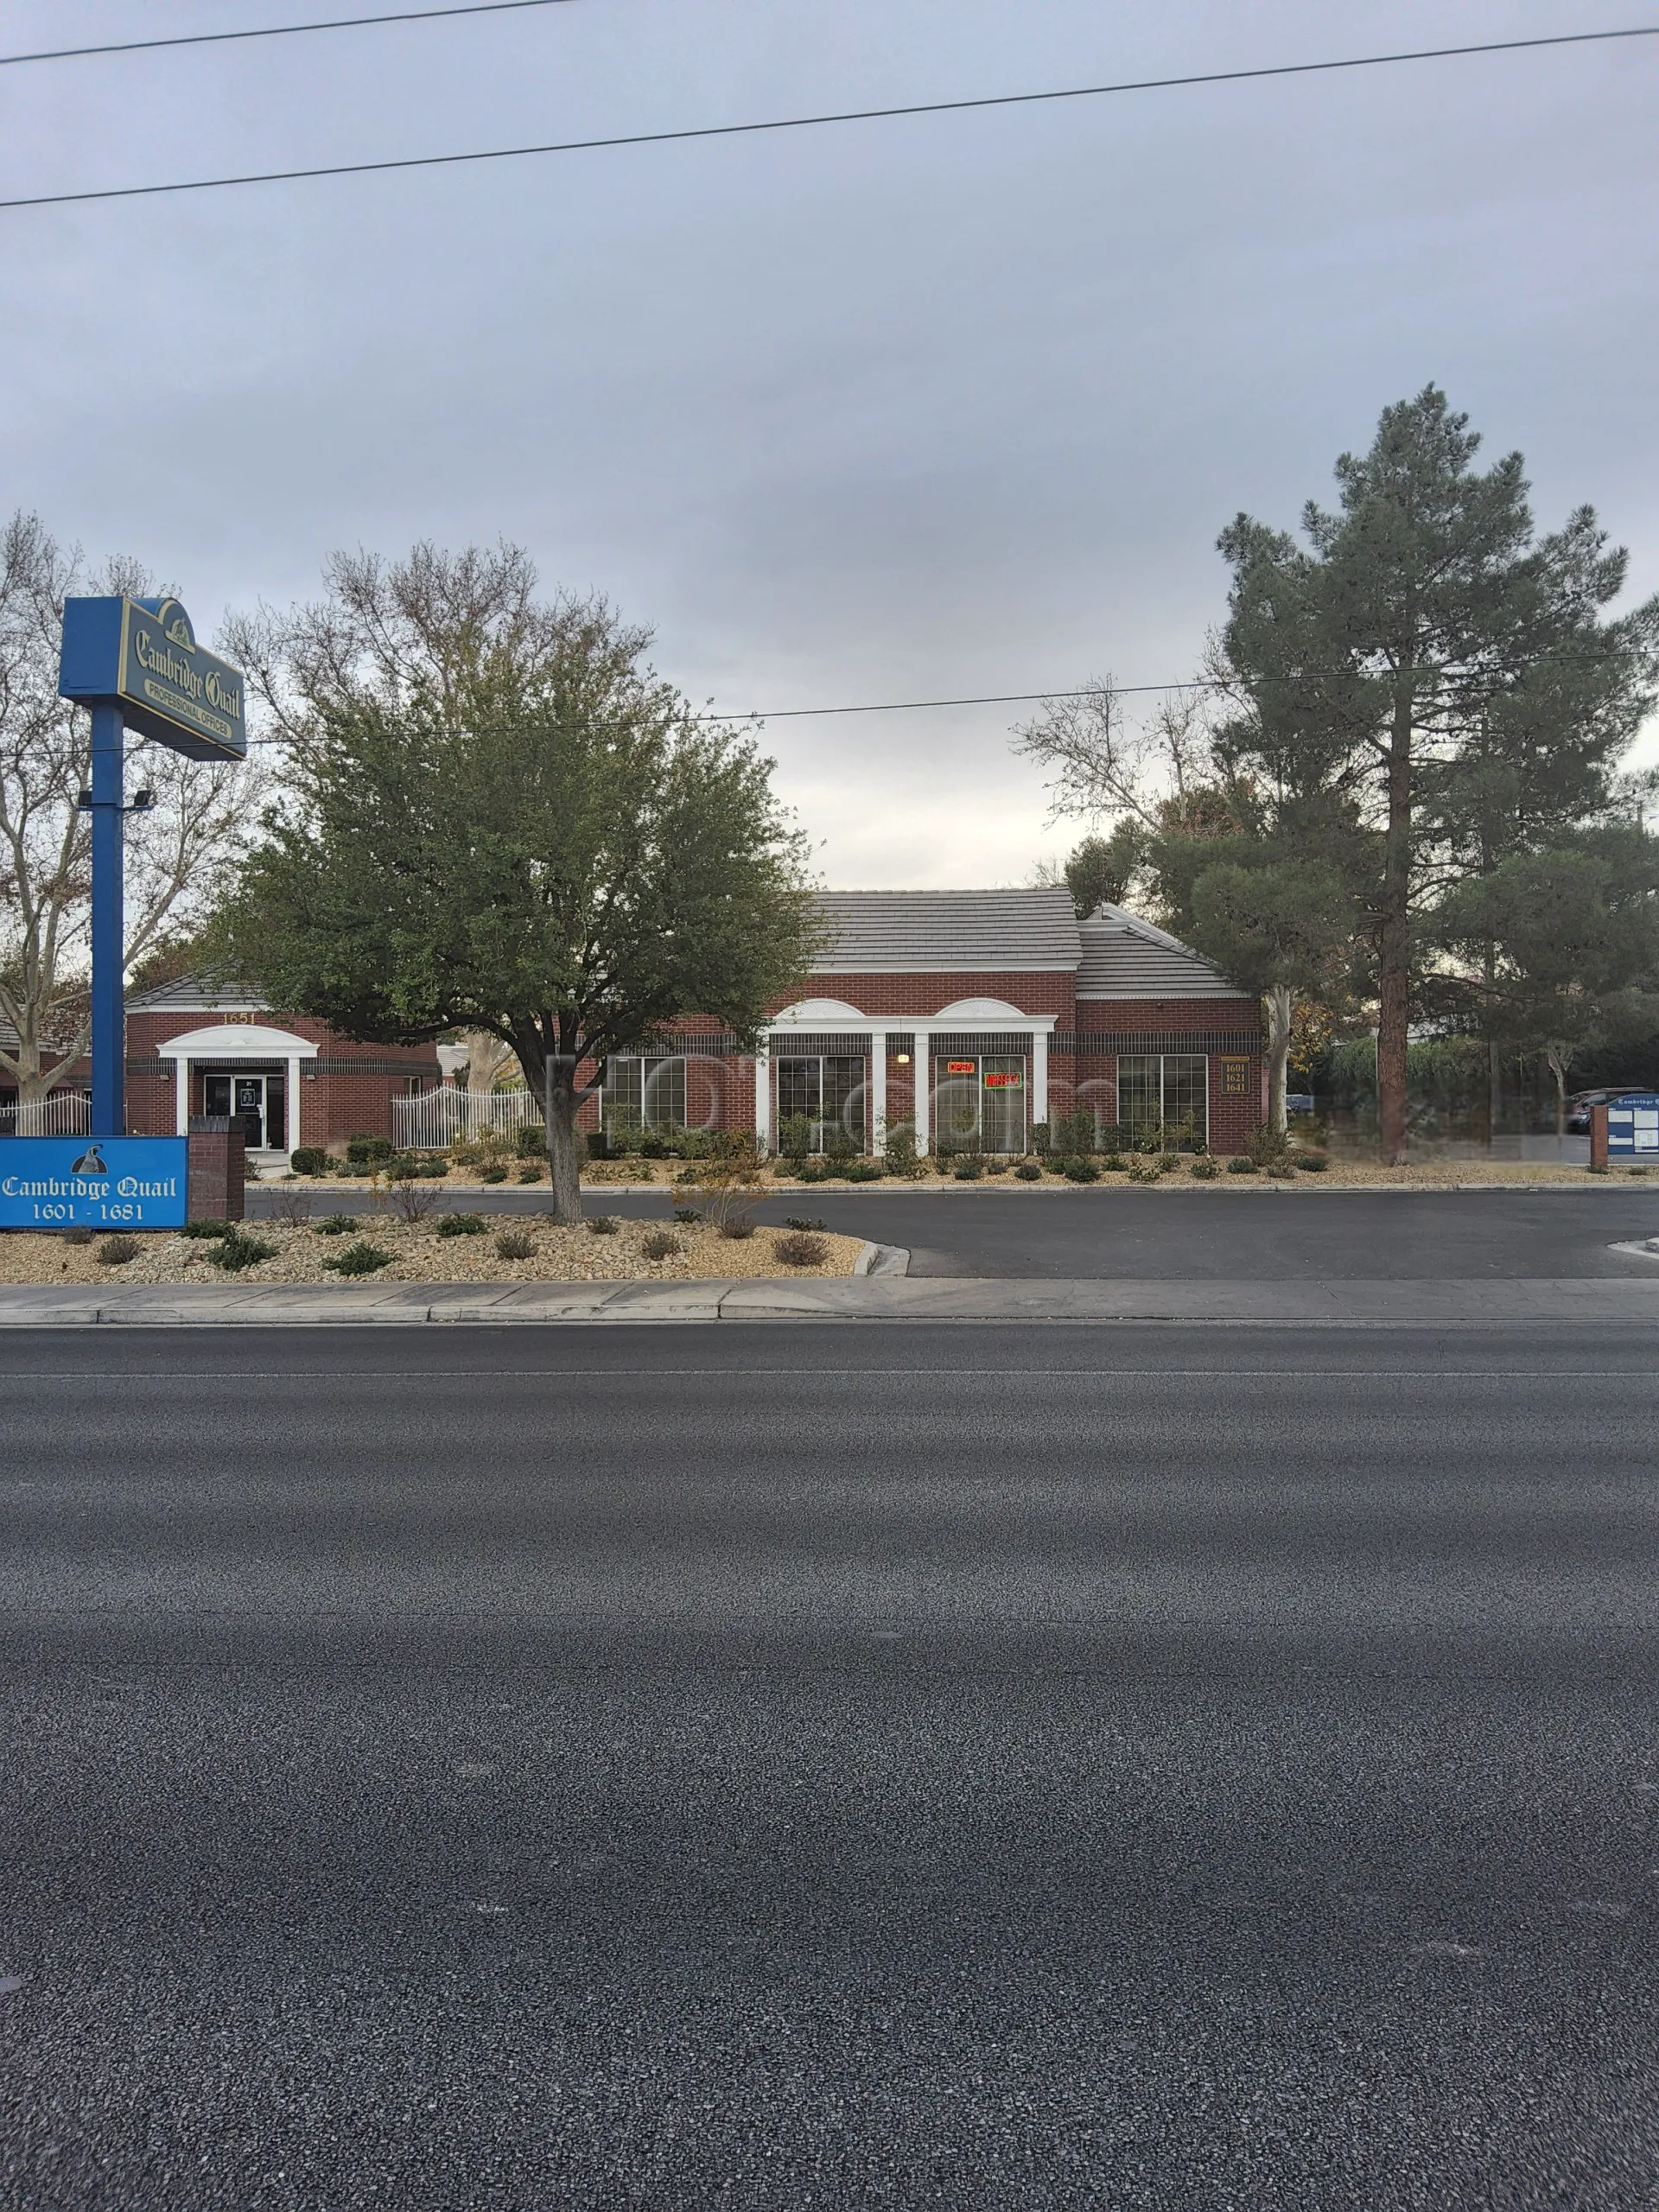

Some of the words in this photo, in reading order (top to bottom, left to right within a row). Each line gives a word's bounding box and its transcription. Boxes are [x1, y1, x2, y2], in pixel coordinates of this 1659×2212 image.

[135, 629, 203, 701] Cambridge
[204, 671, 241, 721] Quail
[149, 683, 201, 720] PROFESSIONAL
[201, 712, 228, 735] OFFICES
[223, 1012, 256, 1025] 1651
[949, 1063, 974, 1071] OPEN
[1227, 1064, 1245, 1072] 1601
[986, 1073, 1020, 1086] MASSAGE
[1227, 1073, 1245, 1082] 1621
[1227, 1083, 1245, 1091] 1641
[2, 1176, 111, 1200] Cambridge
[117, 1176, 176, 1198] Quail
[33, 1204, 76, 1220] 1601
[99, 1204, 143, 1220] 1681
